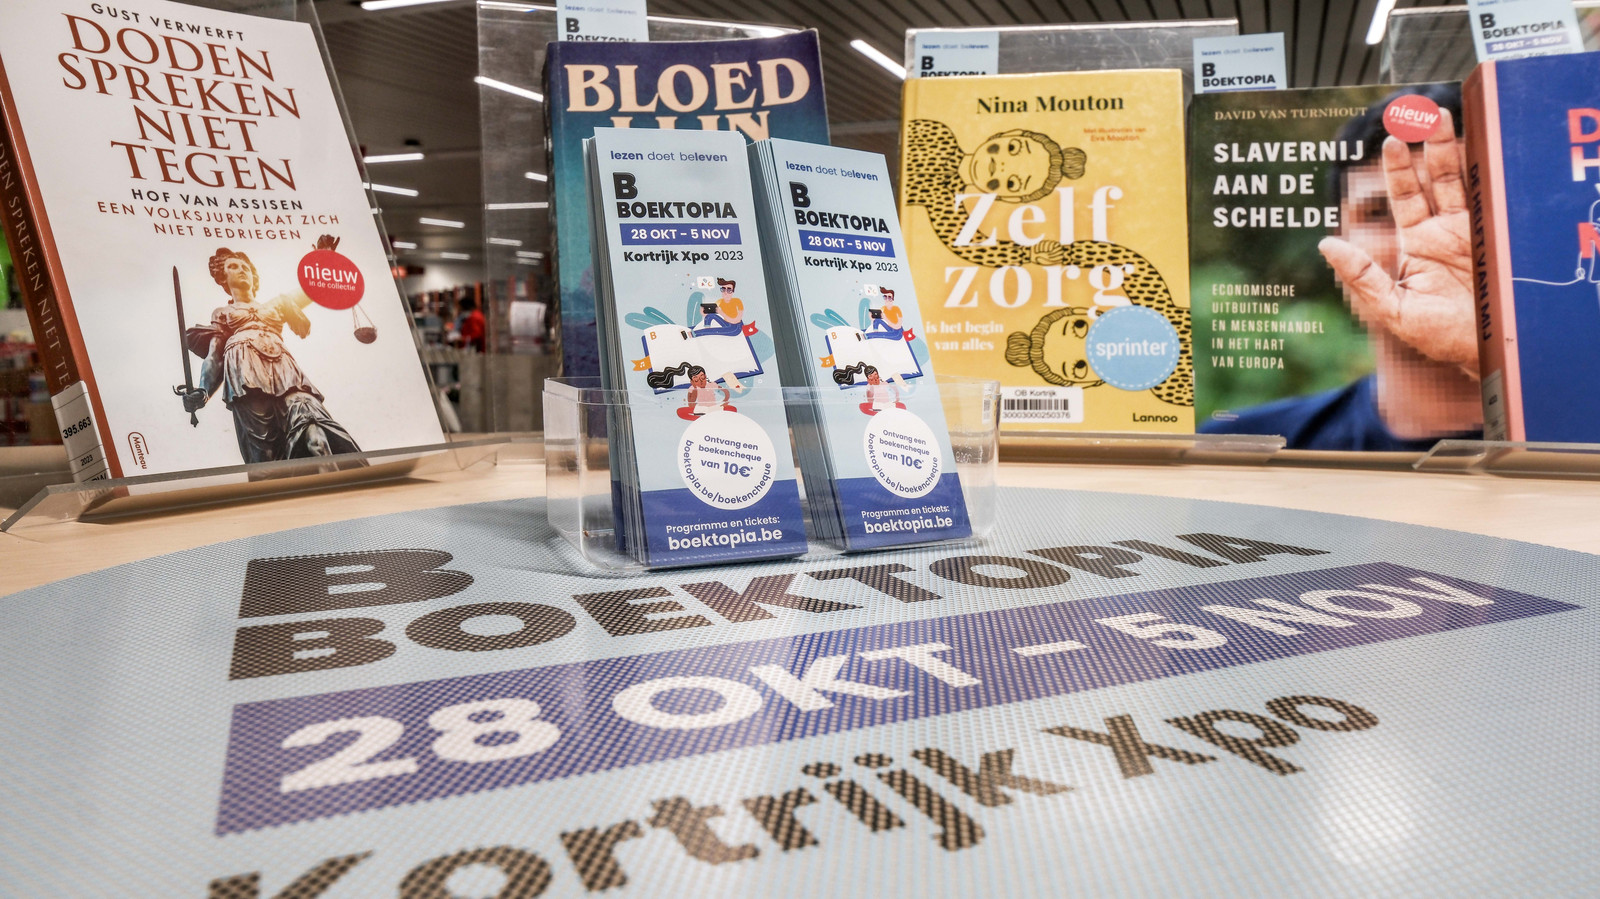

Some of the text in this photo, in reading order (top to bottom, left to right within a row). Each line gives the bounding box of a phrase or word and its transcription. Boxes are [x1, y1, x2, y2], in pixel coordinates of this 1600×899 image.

[91, 3, 245, 42] GUST VERWERFT
[566, 18, 580, 33] B
[1480, 13, 1496, 29] B
[1483, 20, 1565, 39] BOEKTOPIA
[61, 13, 275, 82] DODEN
[566, 34, 638, 42] BOEKTO
[921, 56, 934, 70] B
[1202, 62, 1216, 77] B
[58, 53, 301, 120] SPREKEN
[564, 58, 811, 112] BLOED
[1203, 74, 1276, 87] BOEKTOPIA
[977, 96, 1124, 115] Nina Mouton
[1214, 106, 1368, 121] DAVID VAN TURNHOUT
[1389, 105, 1439, 124] nieuw
[133, 105, 260, 153] NIET
[610, 150, 728, 162] lezen doet beleven
[1213, 140, 1364, 163] SLAVERNIJ
[110, 140, 297, 192] TEGEN
[786, 161, 879, 181] lezen doet beleven
[613, 172, 638, 199] B
[1213, 173, 1315, 195] AAN DE
[131, 188, 303, 211] HOF VAN ASSISEN
[789, 181, 811, 208] B
[97, 201, 340, 226] EEN VOLKSJURY LAAT ZICH
[616, 202, 738, 218] BOEKTOPIA
[1213, 206, 1339, 228] SCHELDE
[794, 209, 891, 233] BOEKTOPIA
[154, 223, 302, 241] NIET BEDRIEGEN
[631, 229, 648, 239] 28
[650, 229, 677, 239] OKT
[690, 229, 699, 239] 5
[701, 229, 730, 239] NOV
[808, 235, 822, 247] 28
[823, 237, 845, 249] OKT
[855, 239, 862, 250] 5
[863, 241, 886, 252] NOV
[1470, 163, 1492, 341] DE HELFT VAN MIJ
[624, 250, 744, 264] Kortrijk Xpo 2023
[804, 256, 899, 273] Kortrijk Xpo 2023
[9, 196, 43, 292] SPREKEN
[38, 298, 61, 350] NIET
[304, 263, 358, 284] nieuw
[327, 282, 356, 291] collectie
[944, 263, 1135, 320] zorg
[1212, 284, 1295, 297] ECONOMISCHE
[1212, 302, 1279, 315] UITBUITING
[926, 320, 1004, 337] is het begin
[1212, 319, 1325, 334] EN MENSENHANDEL
[934, 337, 994, 351] van alles
[1096, 338, 1169, 360] sprinter
[1212, 338, 1285, 351] IN HET HART
[1212, 356, 1285, 369] VAN EUROPA
[1015, 389, 1057, 397] OB Kortrijk
[62, 416, 92, 439] 395.663
[1133, 413, 1178, 423] Lannoo
[704, 434, 759, 451] Ontvang een
[879, 437, 930, 456] boekencheque
[882, 429, 927, 446] Ontvang een
[80, 454, 94, 466] 2023
[133, 436, 147, 470] Manteau
[698, 444, 762, 462] boekencheque
[882, 451, 898, 461] van
[683, 439, 772, 504] boektopia.be/boekencheque
[701, 459, 720, 470] van
[868, 432, 938, 494] boektopia.be/boekencheque
[861, 504, 950, 520] Programma en tickets:
[666, 520, 728, 534] Programma
[744, 515, 781, 526] tickets:
[864, 515, 953, 534] boektopia.be
[668, 527, 783, 550] boektopia.be
[237, 549, 475, 620] B
[229, 532, 1330, 681] BOEKTOPIA
[281, 698, 562, 793] 28
[612, 641, 981, 730] OKT
[1095, 612, 1227, 652] 5
[1201, 576, 1493, 634] NOV
[1043, 694, 1380, 778] Xpo
